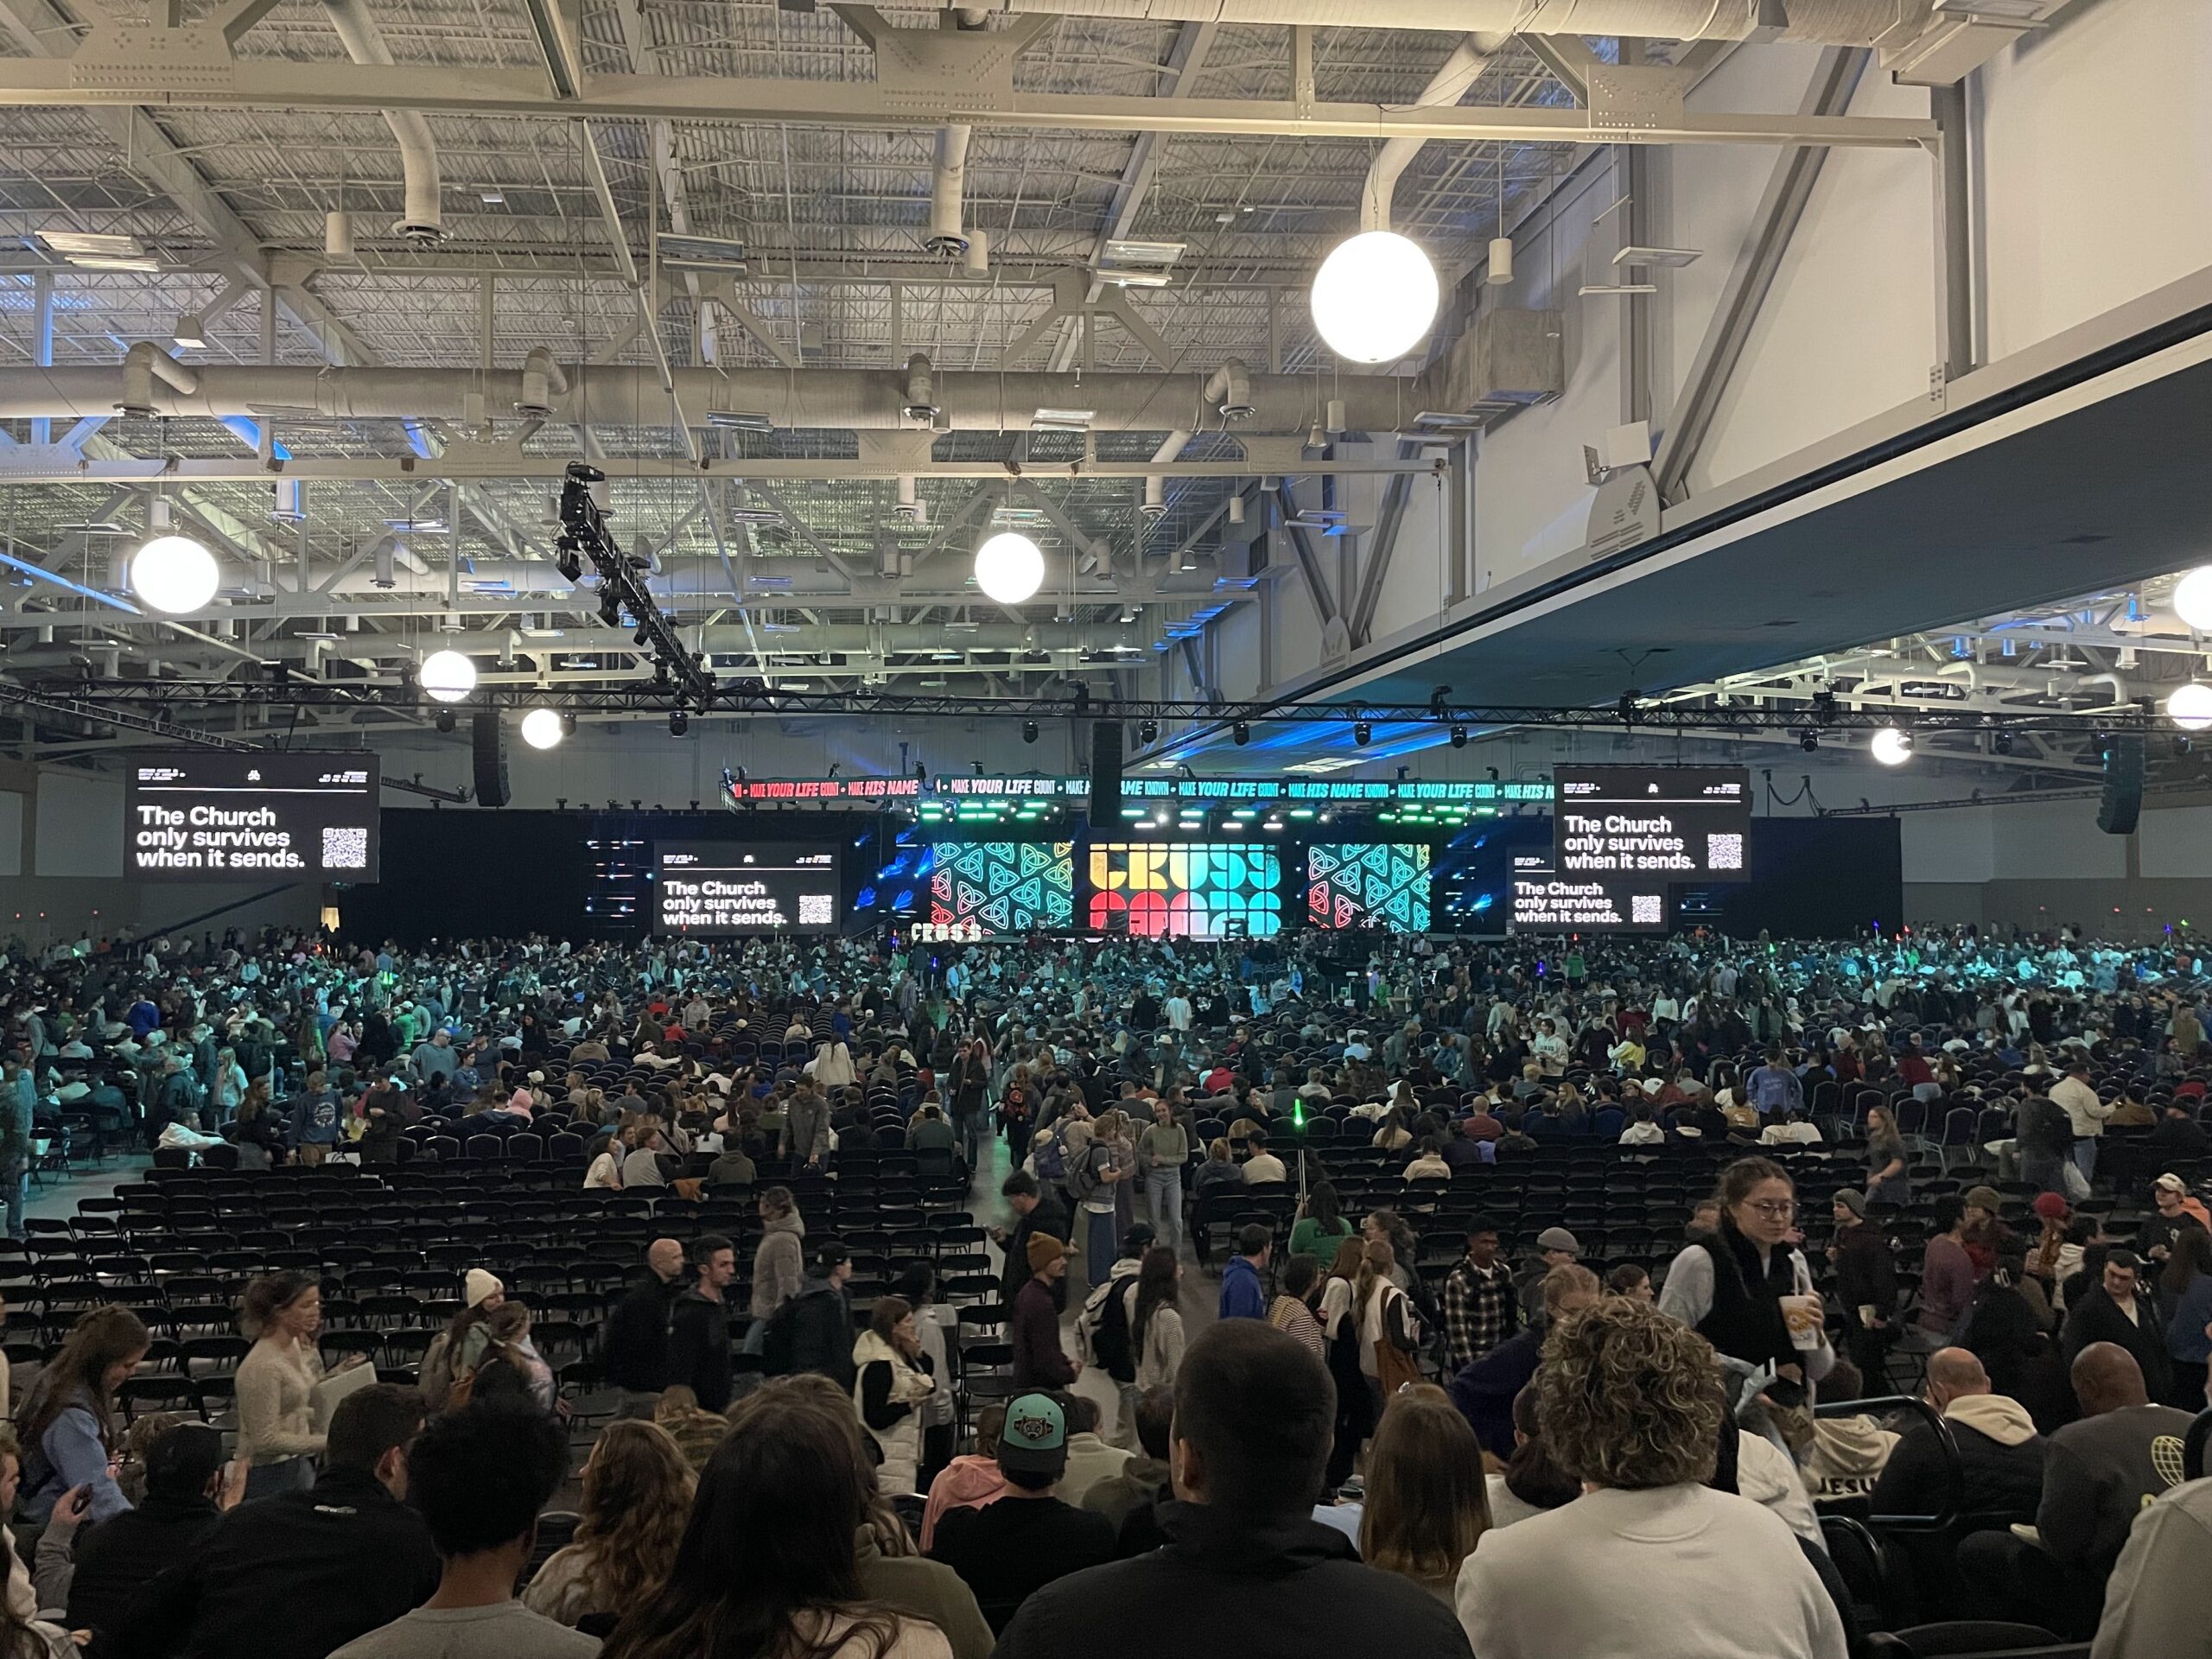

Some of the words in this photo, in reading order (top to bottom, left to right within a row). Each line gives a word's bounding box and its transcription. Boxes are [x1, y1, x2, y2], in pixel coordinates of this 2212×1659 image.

[750, 784, 766, 798] MAKE
[767, 783, 794, 797] YOUR
[795, 783, 819, 797] LIFE
[820, 782, 839, 796] COUNT
[849, 781, 864, 796] MAKE
[865, 780, 886, 795] HIS
[887, 779, 918, 794] NAME
[951, 779, 970, 793] MAKE
[971, 779, 1003, 794] YOUR
[1005, 779, 1033, 794] LIFE
[1033, 779, 1055, 794] COUNT
[1065, 780, 1084, 794] MAKE
[1145, 781, 1169, 795] KNOWN
[1179, 782, 1197, 796] MAKE
[1198, 782, 1229, 797] YOUR
[1230, 782, 1257, 797] LIFE
[1258, 783, 1279, 797] COUNT
[1288, 783, 1306, 797] MAKE
[1306, 783, 1329, 798] HIS
[1330, 784, 1363, 798] NAME
[1364, 784, 1389, 798] KNOWN
[1398, 784, 1415, 798] MAKE
[1417, 784, 1446, 798] YOUR
[1447, 784, 1473, 798] LIFE
[1475, 784, 1496, 798] COUNT
[1504, 785, 1522, 798] MAKE
[1522, 785, 1546, 799] HIS
[137, 806, 185, 825] The
[190, 806, 276, 826] Church
[1564, 815, 1601, 833] The
[1605, 815, 1672, 833] Church
[137, 828, 188, 850] only
[193, 828, 290, 847] survives
[1565, 834, 1605, 855] only
[1608, 834, 1684, 851] survives
[137, 849, 201, 868] when
[207, 849, 225, 868] it
[230, 849, 305, 868] sends.
[1565, 853, 1617, 869] when
[1620, 853, 1633, 869] it
[1637, 853, 1696, 869] sends.
[663, 881, 697, 895] The
[702, 881, 766, 895] Church
[1515, 882, 1544, 895] The
[1548, 882, 1604, 895] Church
[663, 896, 700, 912] only
[704, 896, 776, 910] survives
[1515, 896, 1548, 912] only
[1550, 896, 1612, 909] survives
[663, 911, 711, 925] when
[715, 911, 728, 925] it
[731, 911, 788, 925] sends.
[1515, 910, 1557, 924] when
[1560, 910, 1571, 924] it
[1574, 910, 1623, 924] sends.
[1818, 1478, 1878, 1495] JESU
